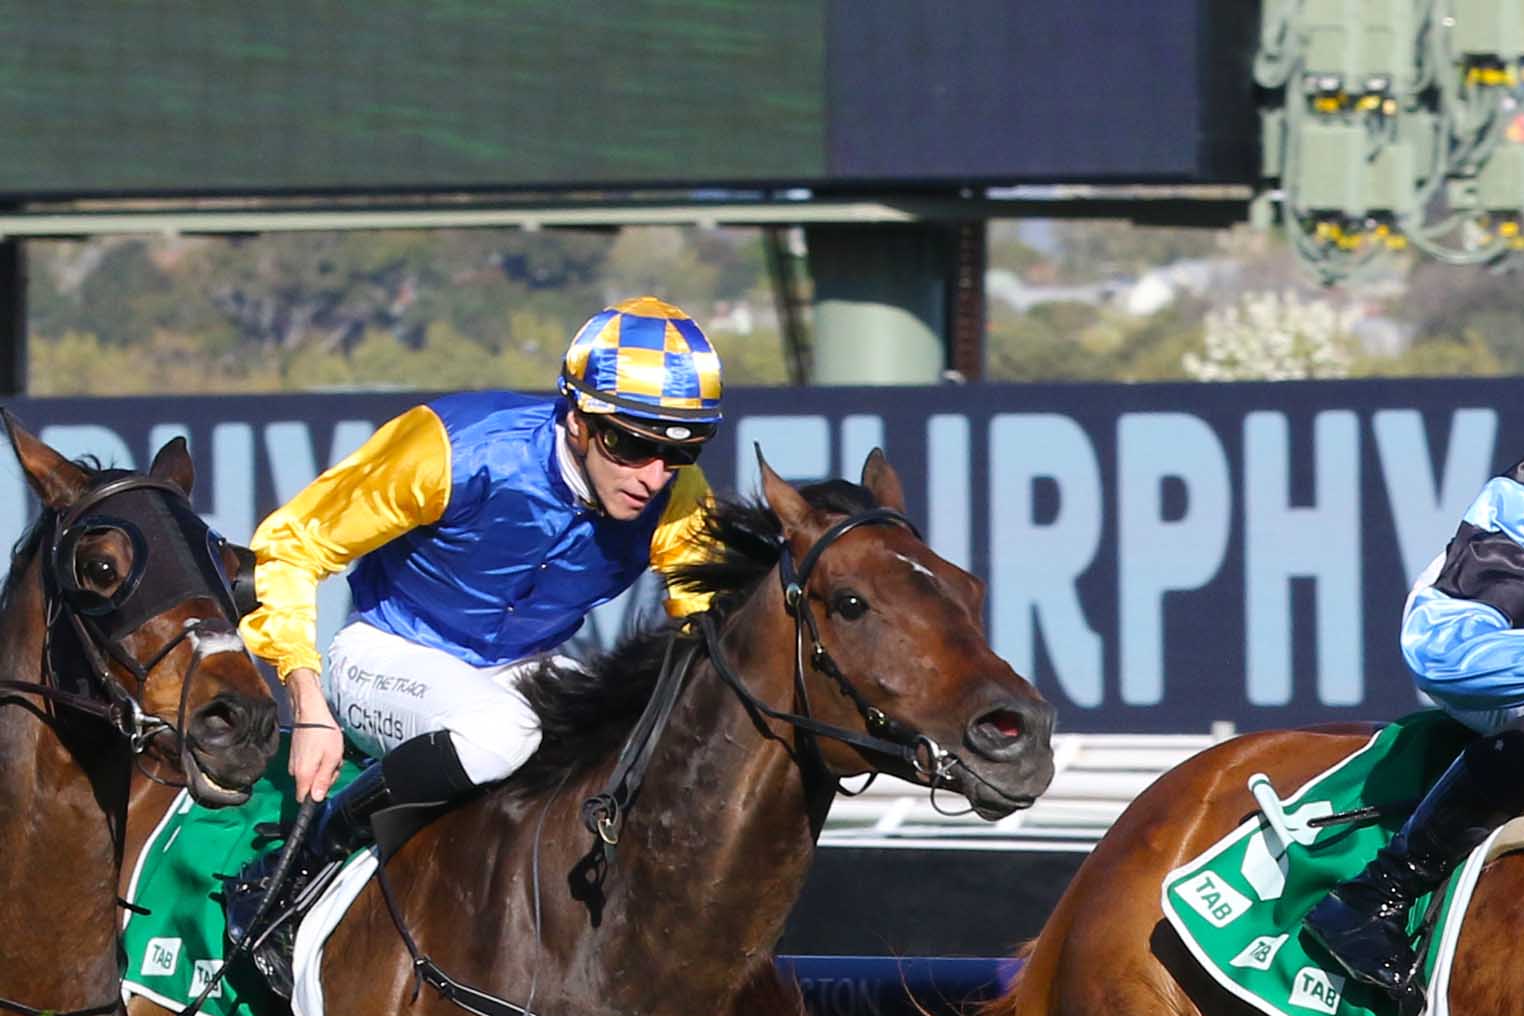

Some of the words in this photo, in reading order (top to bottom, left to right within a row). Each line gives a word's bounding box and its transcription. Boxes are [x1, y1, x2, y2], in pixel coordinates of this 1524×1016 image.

[348, 664, 374, 687] OFF
[348, 703, 404, 741] Childs
[1196, 876, 1232, 920] TAB
[152, 944, 173, 970] TAB
[1303, 973, 1337, 1008] TAB
